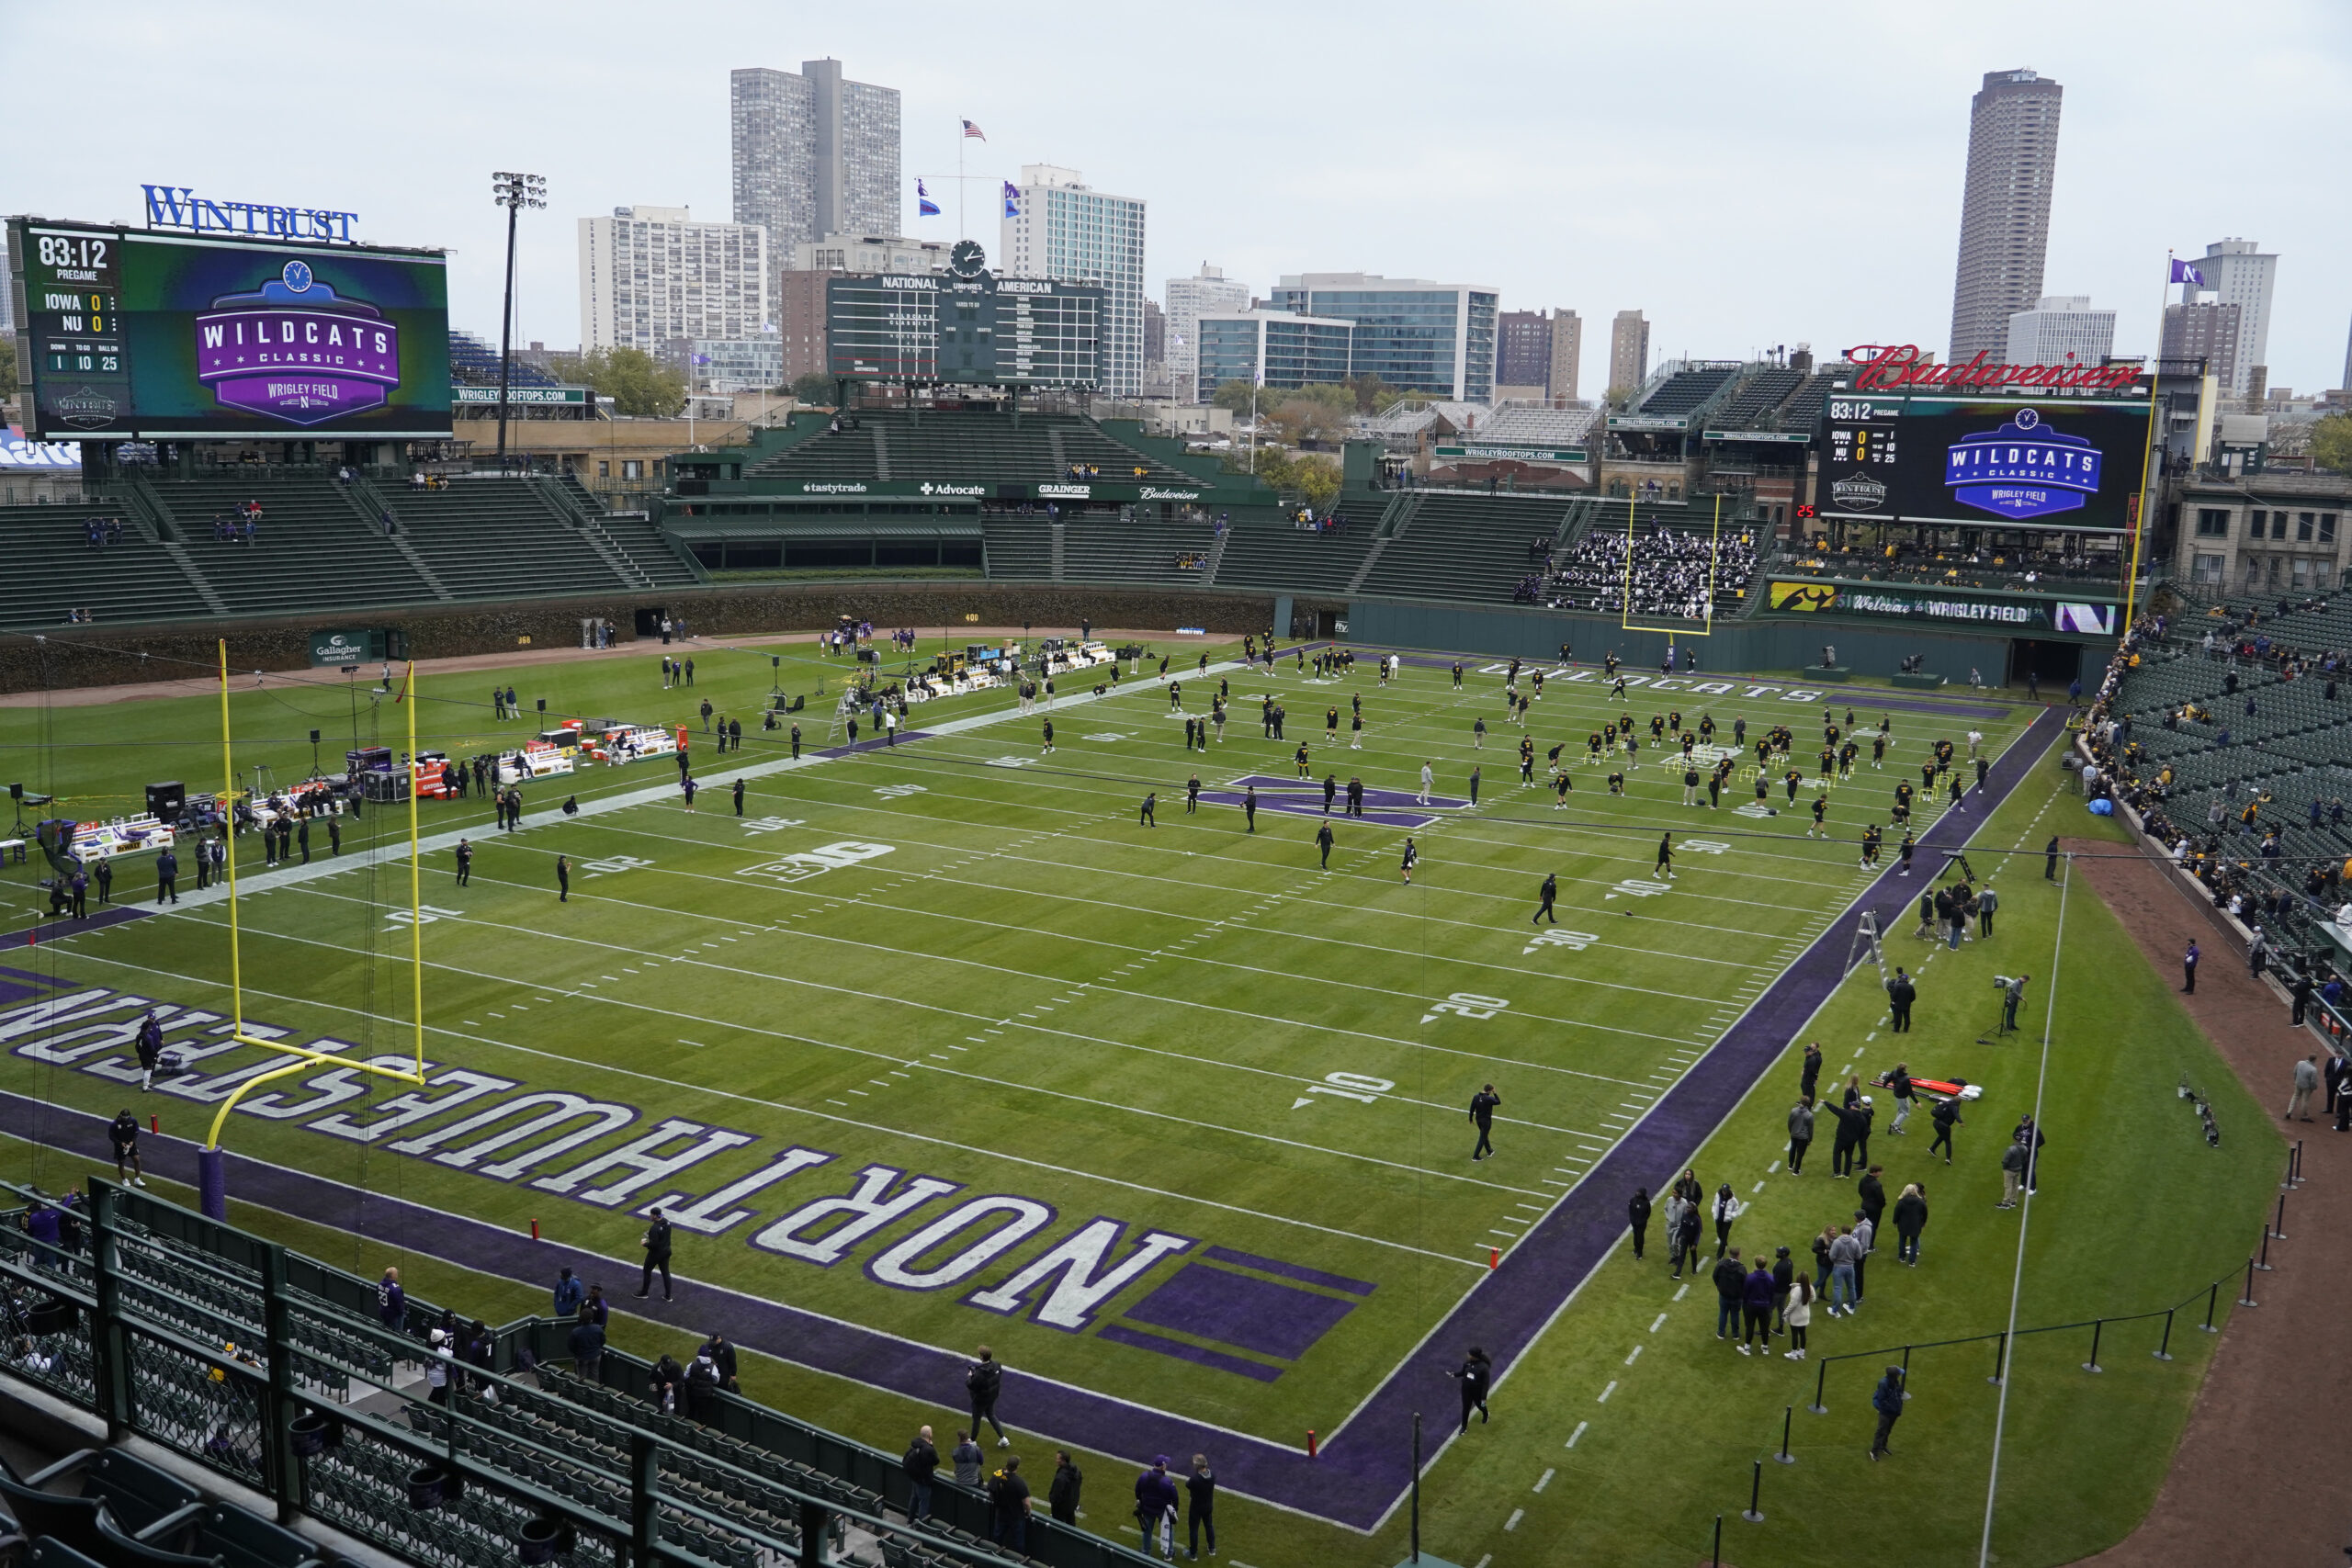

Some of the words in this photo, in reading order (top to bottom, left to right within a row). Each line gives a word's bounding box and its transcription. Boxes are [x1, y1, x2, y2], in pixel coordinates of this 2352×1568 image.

[141, 185, 358, 242] WINTRUST
[39, 236, 107, 268] 83:12
[57, 269, 97, 281] PREGAME
[883, 276, 939, 289] NATIONAL
[953, 282, 983, 290] UMPIRES
[996, 281, 1051, 294] AMERICAN
[45, 294, 81, 310] IOWA
[92, 295, 101, 311] 0
[62, 315, 83, 332] NU
[92, 315, 103, 333] 0
[204, 321, 387, 354] WILDCATS
[57, 355, 62, 369] 1
[78, 355, 92, 370] 10
[102, 356, 118, 370] 25
[259, 353, 345, 365] CLASSIC
[1847, 344, 2143, 389] Budweiser
[267, 383, 310, 399] WRIGLEY
[312, 384, 338, 400] FIELD
[1831, 402, 1871, 420] 83:12
[1831, 431, 1851, 441] IOWA
[1858, 431, 1866, 445] 0
[1890, 431, 1894, 440] 1
[1464, 448, 1555, 459] WRIGLEYROOFTOPS.COM
[1836, 448, 1847, 457] NU
[1857, 447, 1865, 461] 0
[1886, 443, 1895, 452] 10
[1884, 454, 1895, 463] 25
[1952, 448, 2093, 472] WILDCATS
[1988, 469, 2054, 479] CLASSIC
[811, 483, 867, 494] tastytrade
[935, 484, 986, 495] Advocate
[1038, 484, 1091, 494] GRAINGER
[1139, 487, 1199, 501] Budweiser
[1992, 489, 2024, 501] WRIGLEY
[2025, 491, 2047, 502] FIELD
[1797, 505, 1814, 518] 25
[1854, 594, 1910, 614] Welcome
[1928, 601, 1986, 619] WRIGLEY
[965, 613, 979, 622] 400
[518, 635, 531, 644] 368
[316, 645, 362, 656] Gallagher
[423, 783, 446, 791] GATOR
[1431, 992, 1510, 1021] 20
[1305, 1071, 1396, 1104] 10
[0, 987, 1193, 1330] NORTHWESTERN
